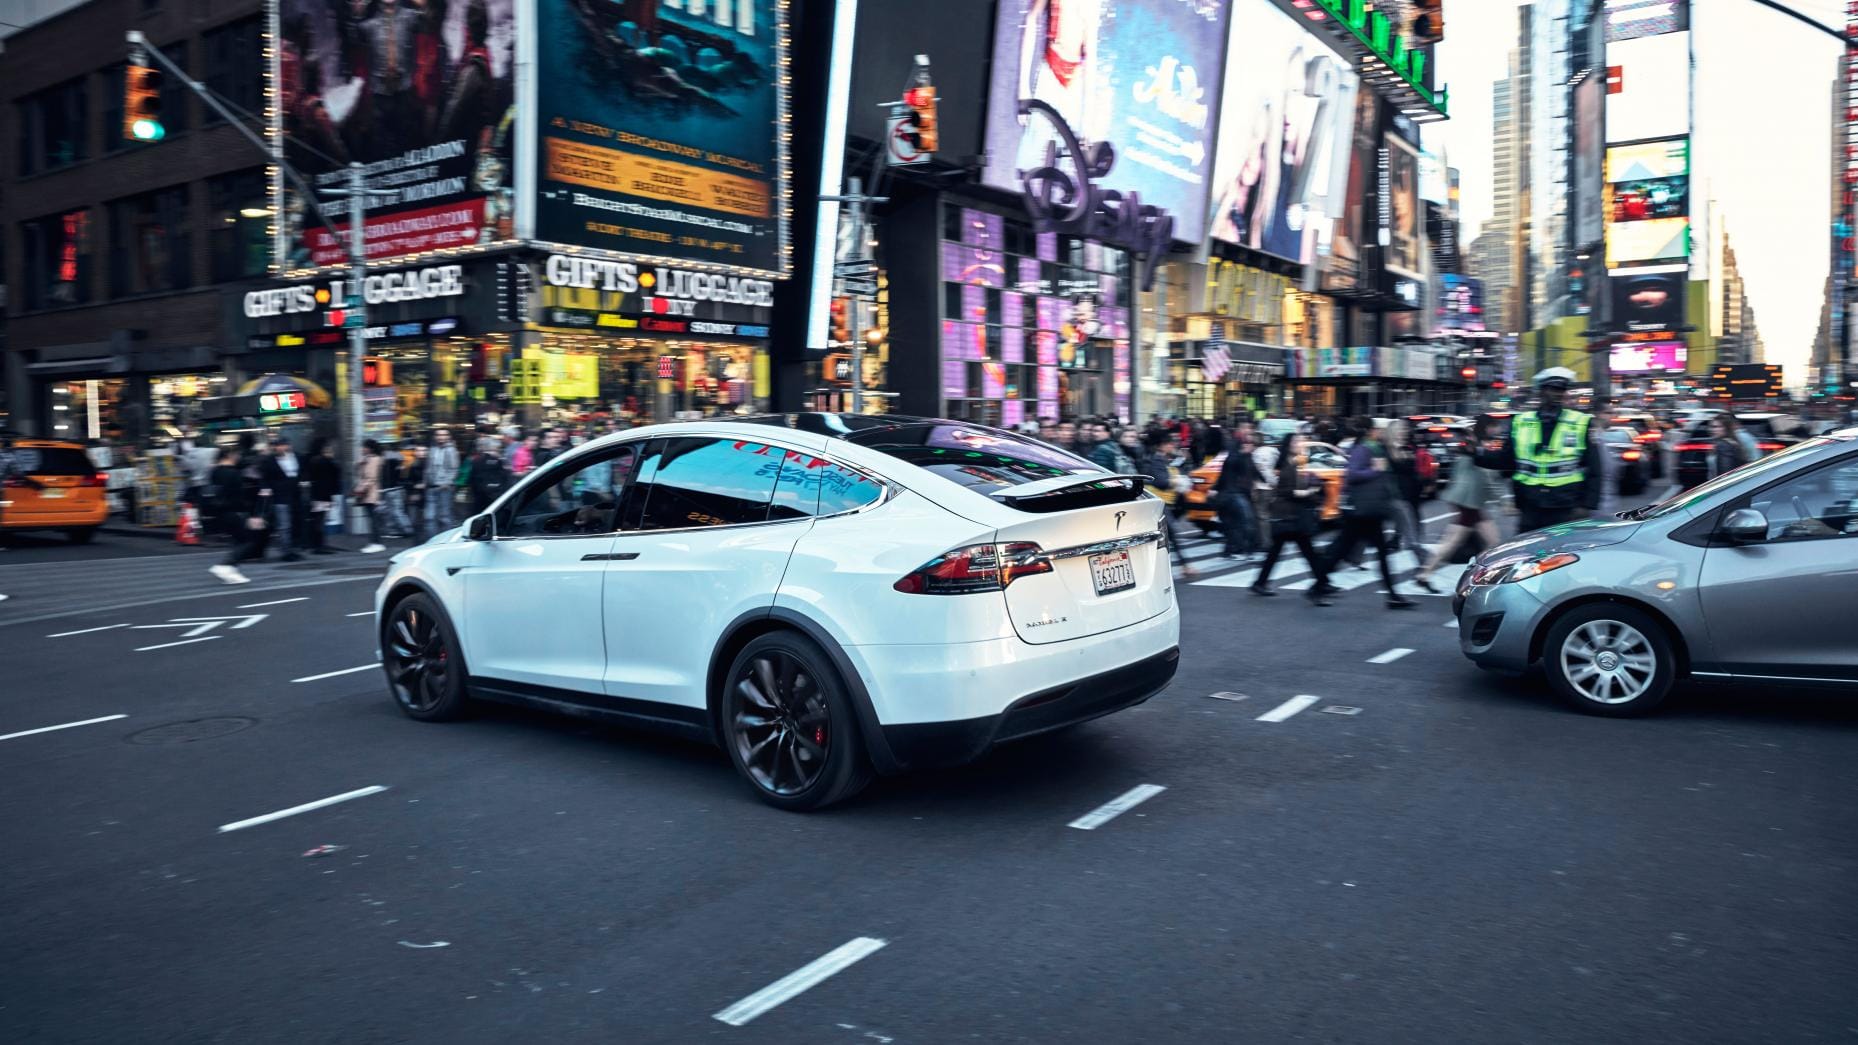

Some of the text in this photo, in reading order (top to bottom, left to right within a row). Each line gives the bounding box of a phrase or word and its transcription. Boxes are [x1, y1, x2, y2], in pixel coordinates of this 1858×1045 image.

[244, 264, 464, 318] GIFTS LGGAGE
[546, 254, 775, 307] GIFTS LUGGAGE
[1102, 563, 1126, 586] 63277
